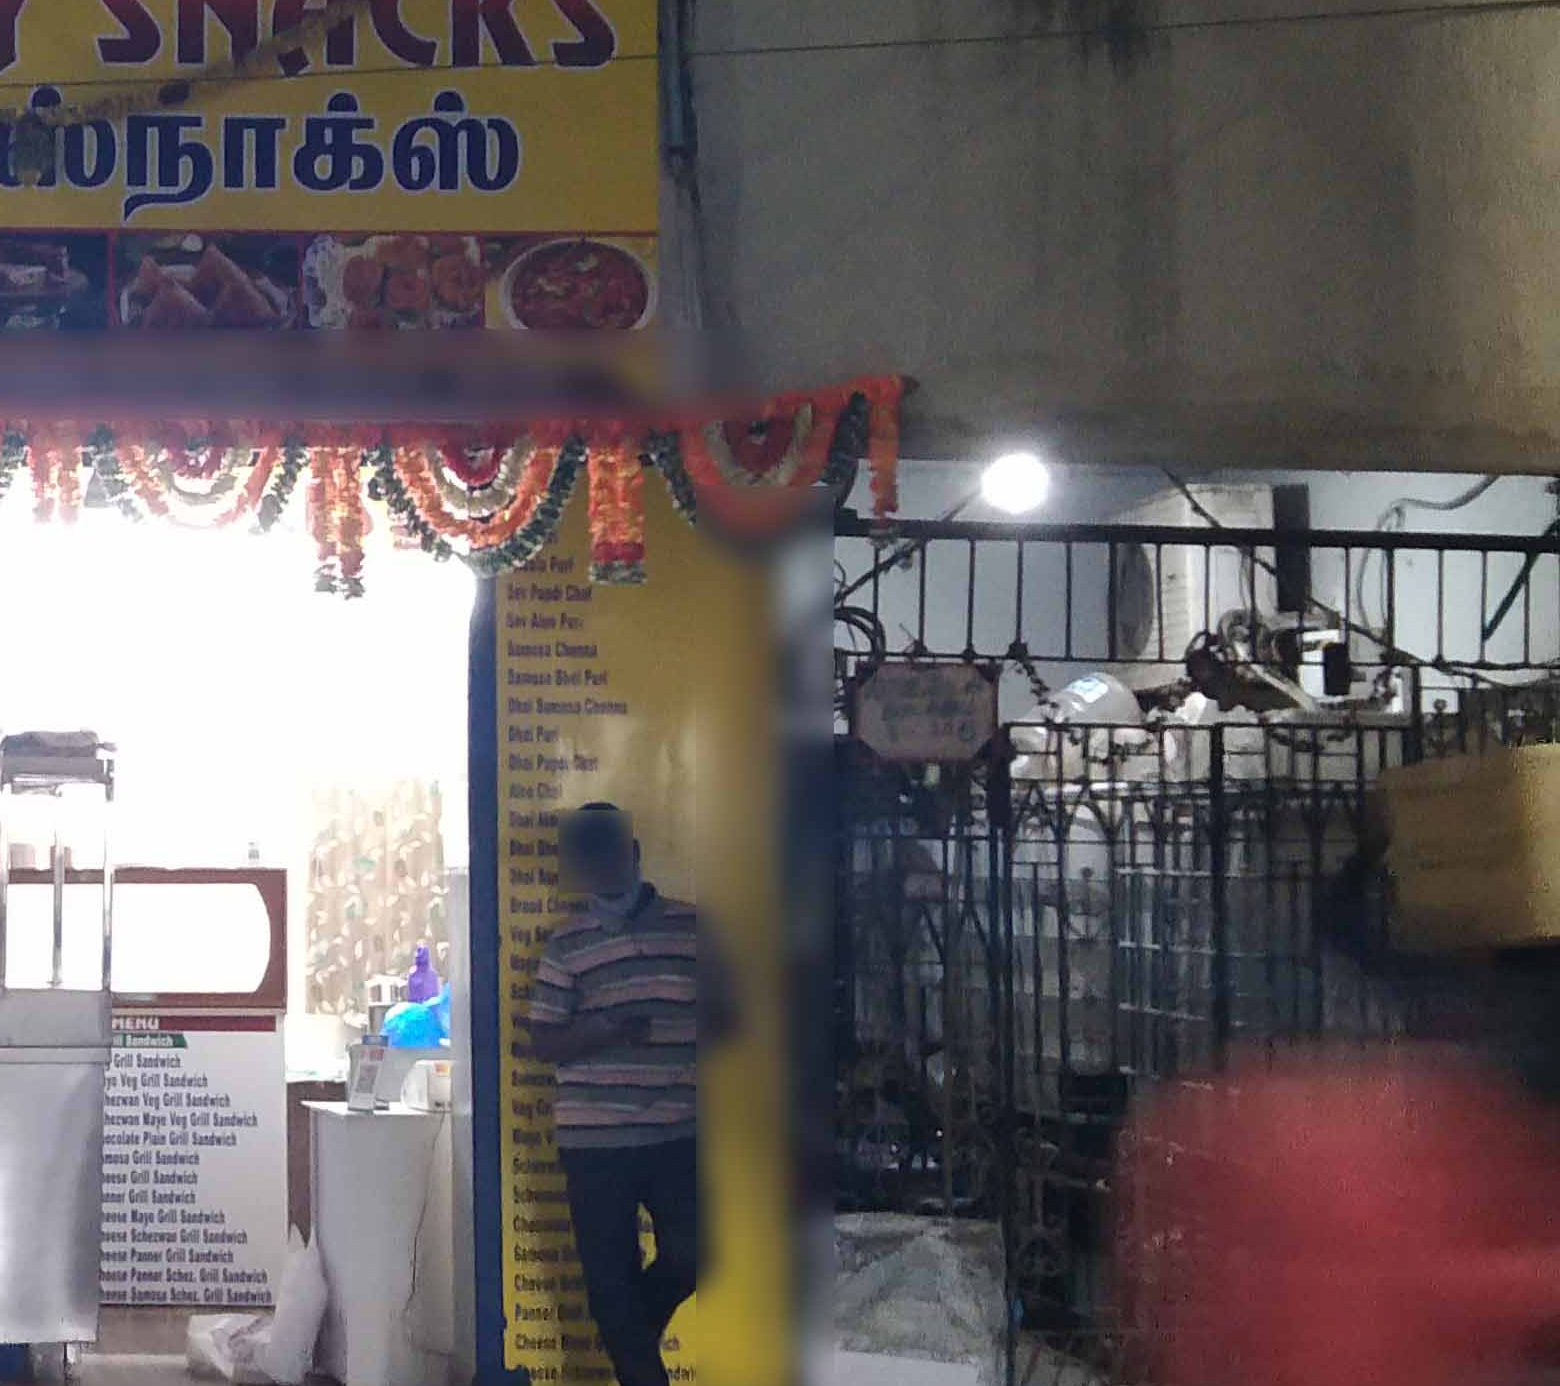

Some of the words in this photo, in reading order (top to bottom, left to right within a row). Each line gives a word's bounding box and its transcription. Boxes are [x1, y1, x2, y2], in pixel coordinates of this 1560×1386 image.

[112, 1018, 159, 1030] MENU
[126, 1034, 173, 1047] Sandwich
[114, 1054, 133, 1068] Grill
[136, 1054, 181, 1068] Sandwich
[119, 1074, 138, 1091] Veg
[140, 1073, 160, 1087] Grill
[163, 1073, 208, 1087] Sandwich
[143, 1093, 160, 1110] Veg
[162, 1093, 183, 1107] Grill
[186, 1093, 231, 1107] Sandwich
[142, 1112, 166, 1129] Mayo
[169, 1112, 187, 1130] Veg
[190, 1112, 209, 1126] Grill
[213, 1112, 258, 1126] Sandwich
[143, 1132, 167, 1145] Plain
[169, 1132, 189, 1145] Grill
[192, 1132, 237, 1145] Sandwich
[132, 1151, 152, 1164] Grill
[155, 1151, 200, 1164] Sandwich
[131, 1170, 150, 1184] Grill
[153, 1170, 198, 1184] Sandwich
[129, 1189, 148, 1203] Grill
[152, 1189, 196, 1203] Sandwich
[131, 1209, 154, 1226] Mayo
[158, 1209, 177, 1223] Grill
[180, 1209, 225, 1223] Sandwich
[131, 1229, 177, 1243] Schezwan
[180, 1229, 200, 1243] Grill
[203, 1229, 248, 1243] Sandwich
[166, 1248, 186, 1262] Grill
[189, 1248, 234, 1262] Sandwich
[199, 1268, 219, 1282] Grill
[222, 1268, 268, 1282] Sandwich
[131, 1287, 167, 1301] Samosa
[203, 1287, 223, 1301] Grill
[227, 1287, 272, 1301] Sandwich
